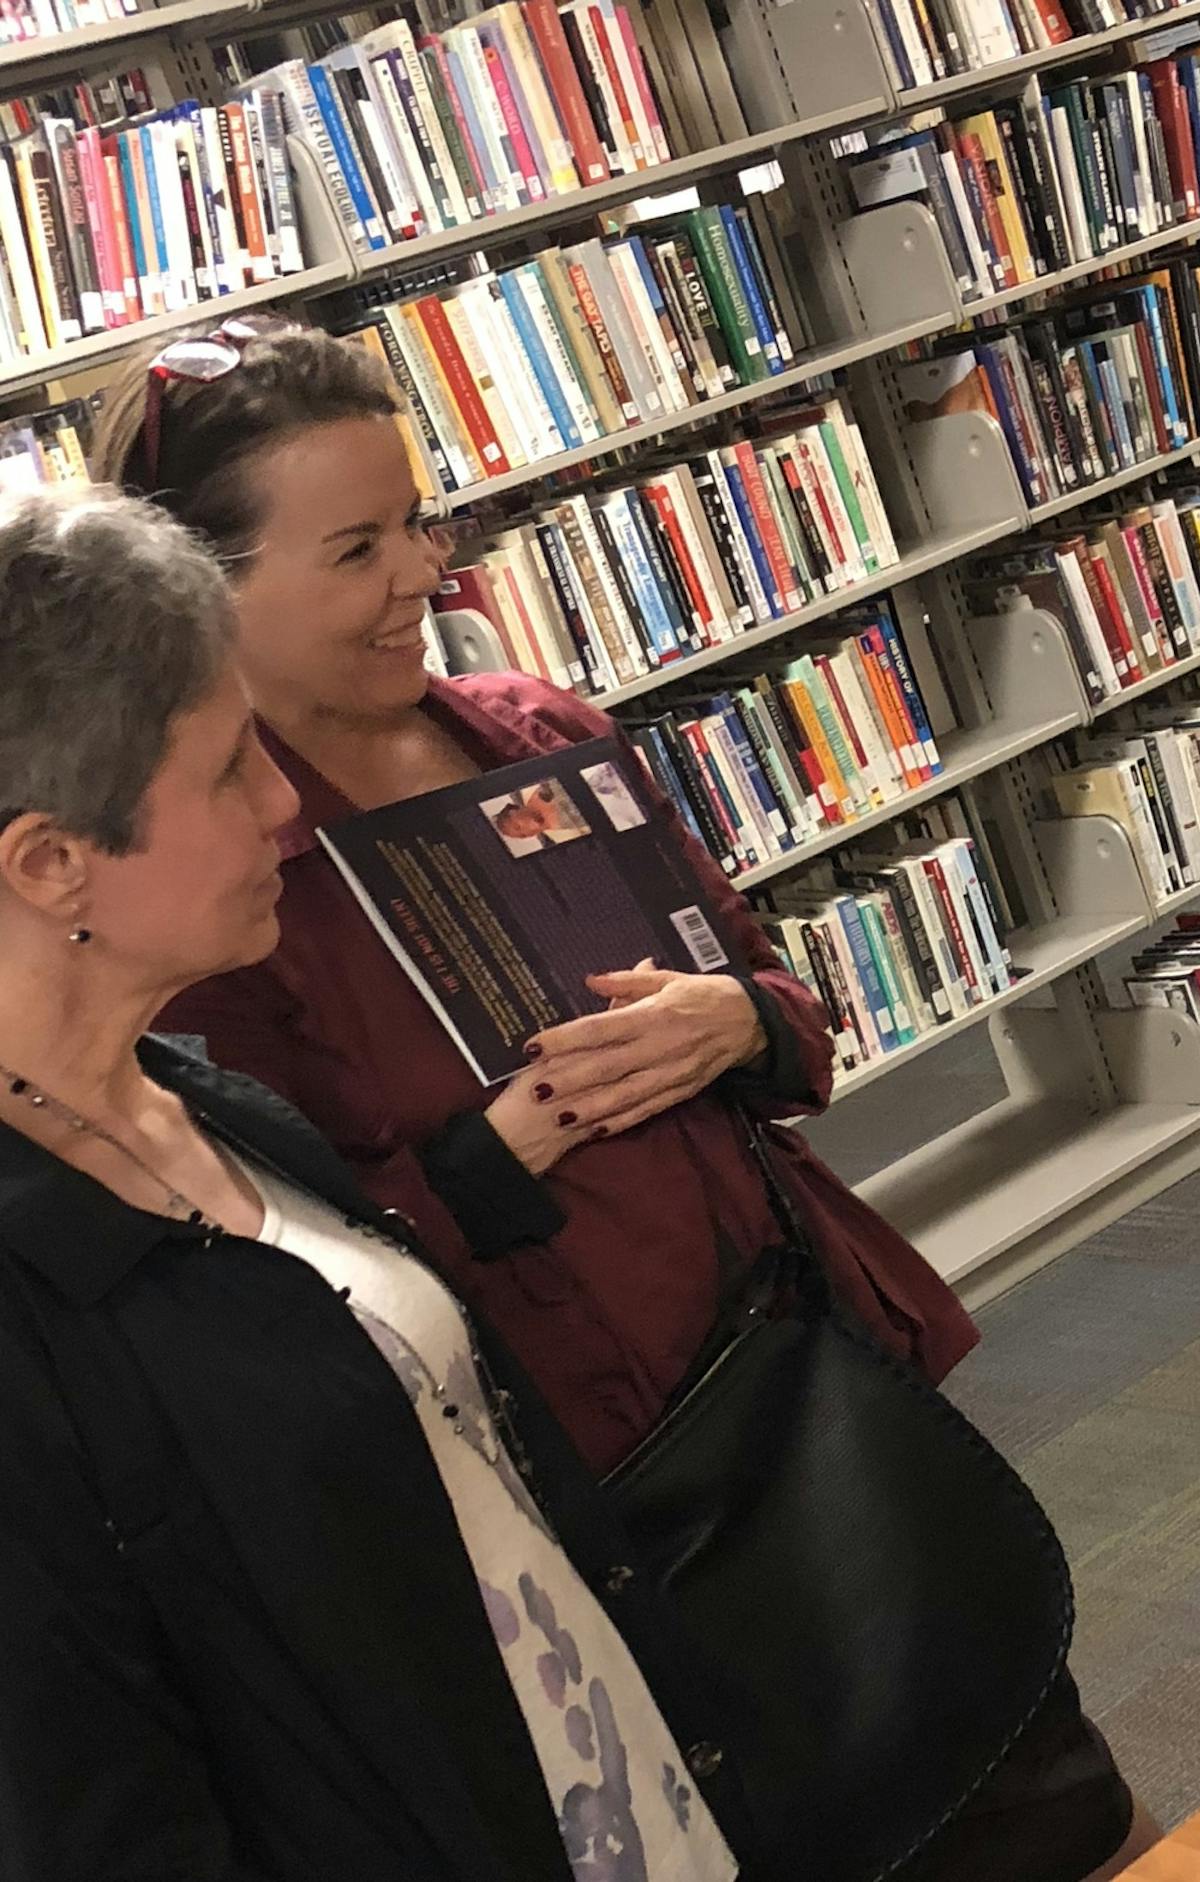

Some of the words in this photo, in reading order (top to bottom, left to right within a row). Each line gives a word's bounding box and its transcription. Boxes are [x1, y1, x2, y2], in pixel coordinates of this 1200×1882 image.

[303, 107, 337, 169] SEXUAL
[1088, 130, 1108, 171] STOLEN
[61, 147, 79, 182] Susan
[969, 142, 998, 216] VISIONS
[67, 183, 87, 226] Sontag
[1095, 171, 1117, 220] GLANCES
[684, 271, 708, 313] LOVE
[703, 223, 754, 329] Homosexuality
[378, 319, 419, 403] FORGIVING
[621, 520, 649, 578] Transgender
[887, 637, 910, 682] HISTORY
[902, 680, 914, 695] OF
[879, 899, 900, 936] AIDS
[413, 931, 435, 956] NOT
